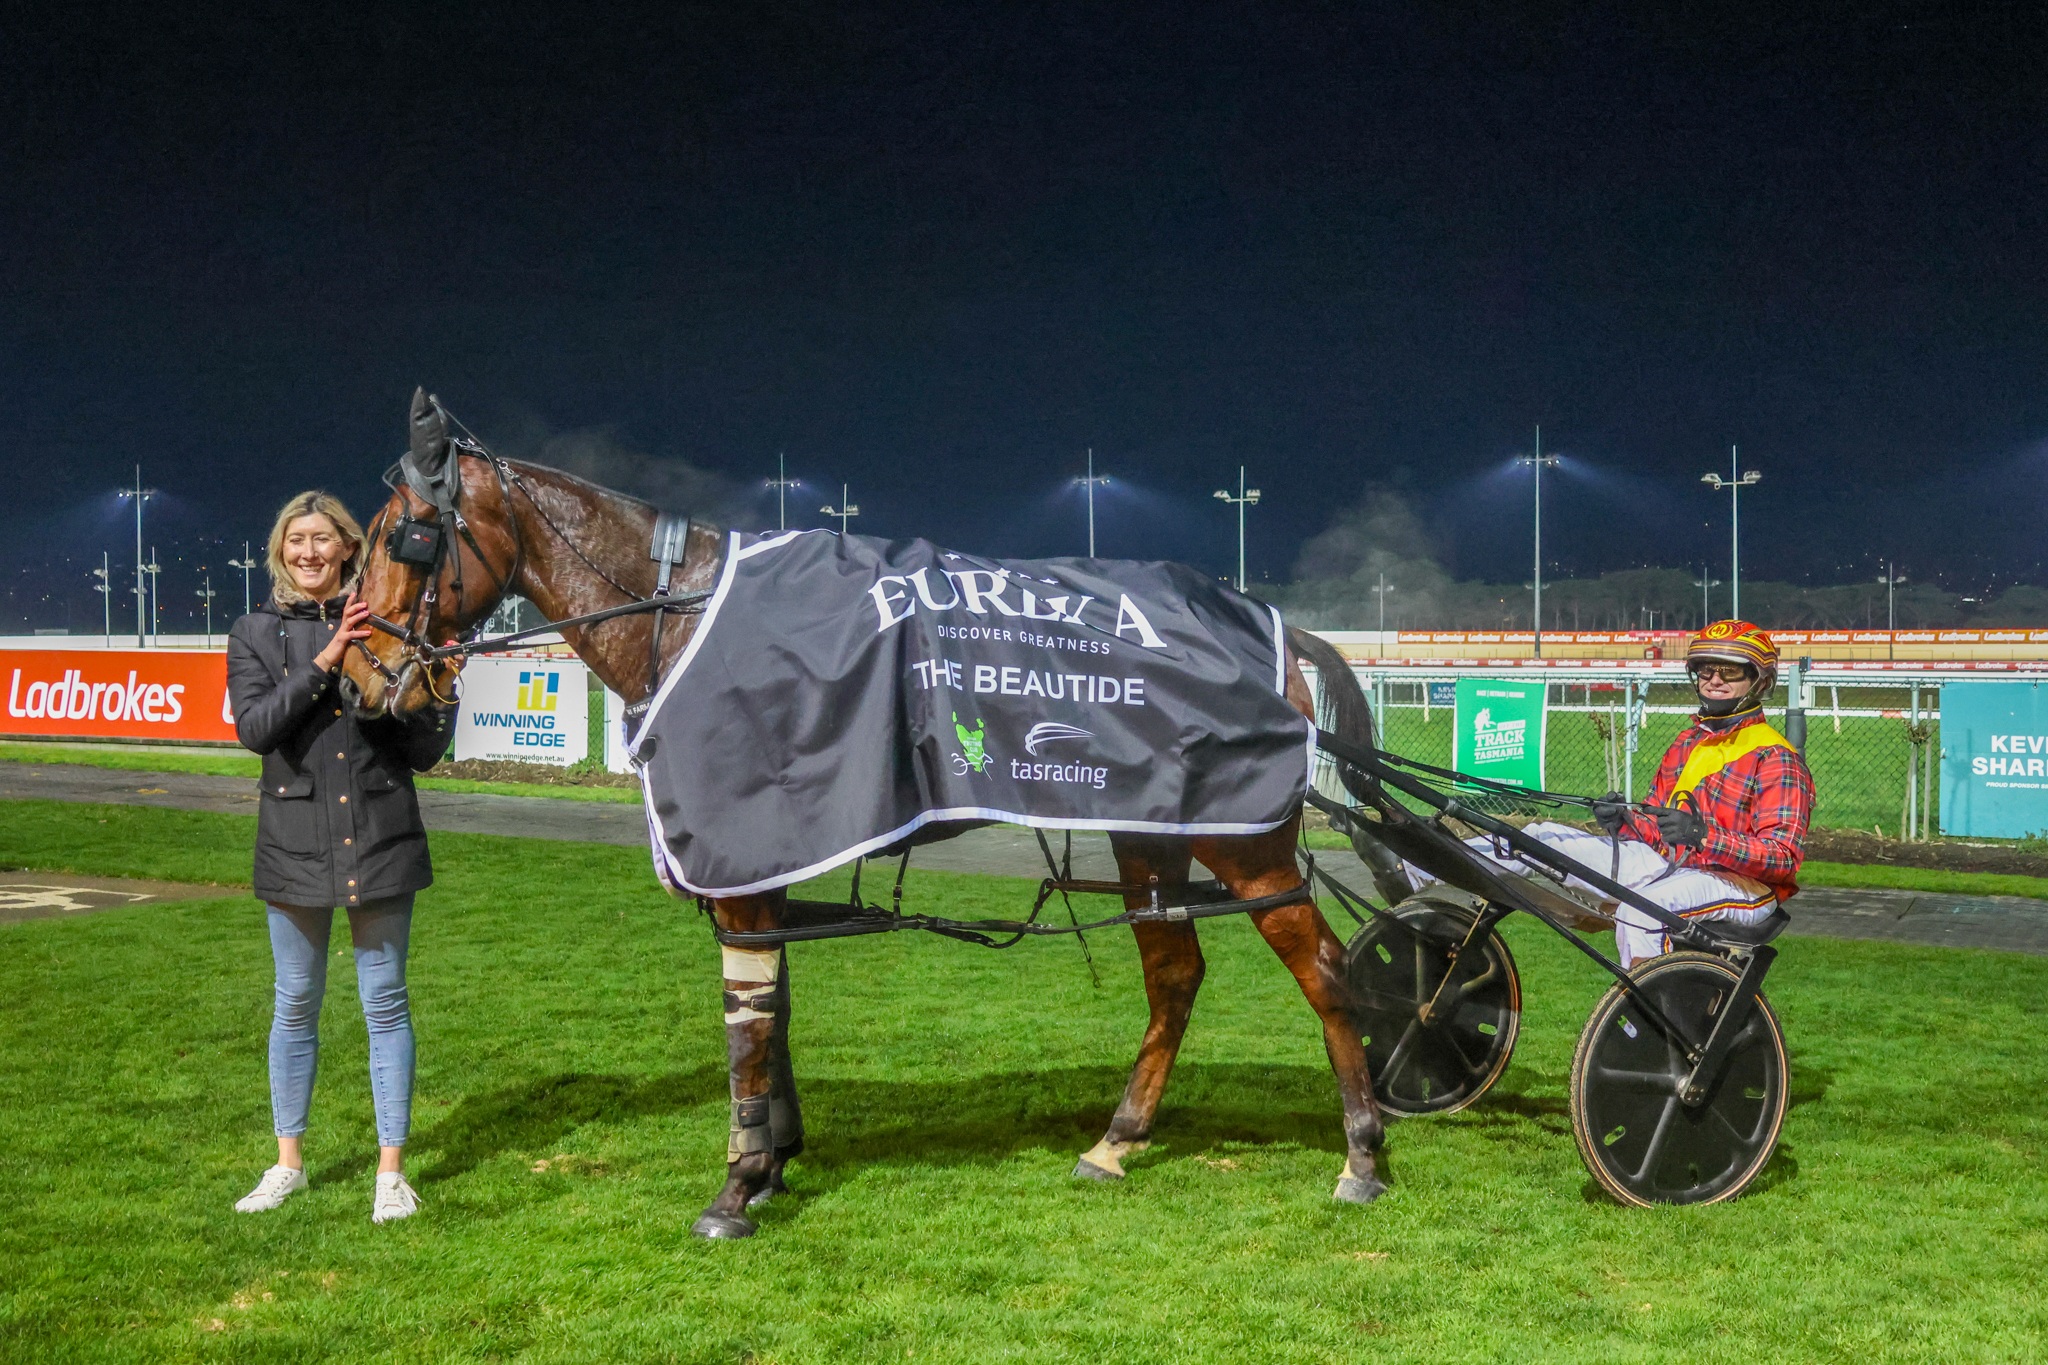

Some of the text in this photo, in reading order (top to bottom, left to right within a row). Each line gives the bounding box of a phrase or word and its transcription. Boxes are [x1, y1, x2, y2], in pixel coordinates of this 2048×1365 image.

[938, 625, 1110, 654] DISCOVER GREATNESS
[912, 658, 1145, 706] THE BEAUTIDE
[8, 668, 185, 723] Ladbrokes
[473, 712, 555, 730] WINNING
[513, 732, 566, 748] EDGE
[1474, 729, 1525, 748] TRACK
[485, 752, 565, 762] www.winningedge.net.au
[1474, 746, 1524, 761] TASMANIA
[1010, 758, 1108, 790] tasracing
[1972, 756, 2048, 777] SHAR
